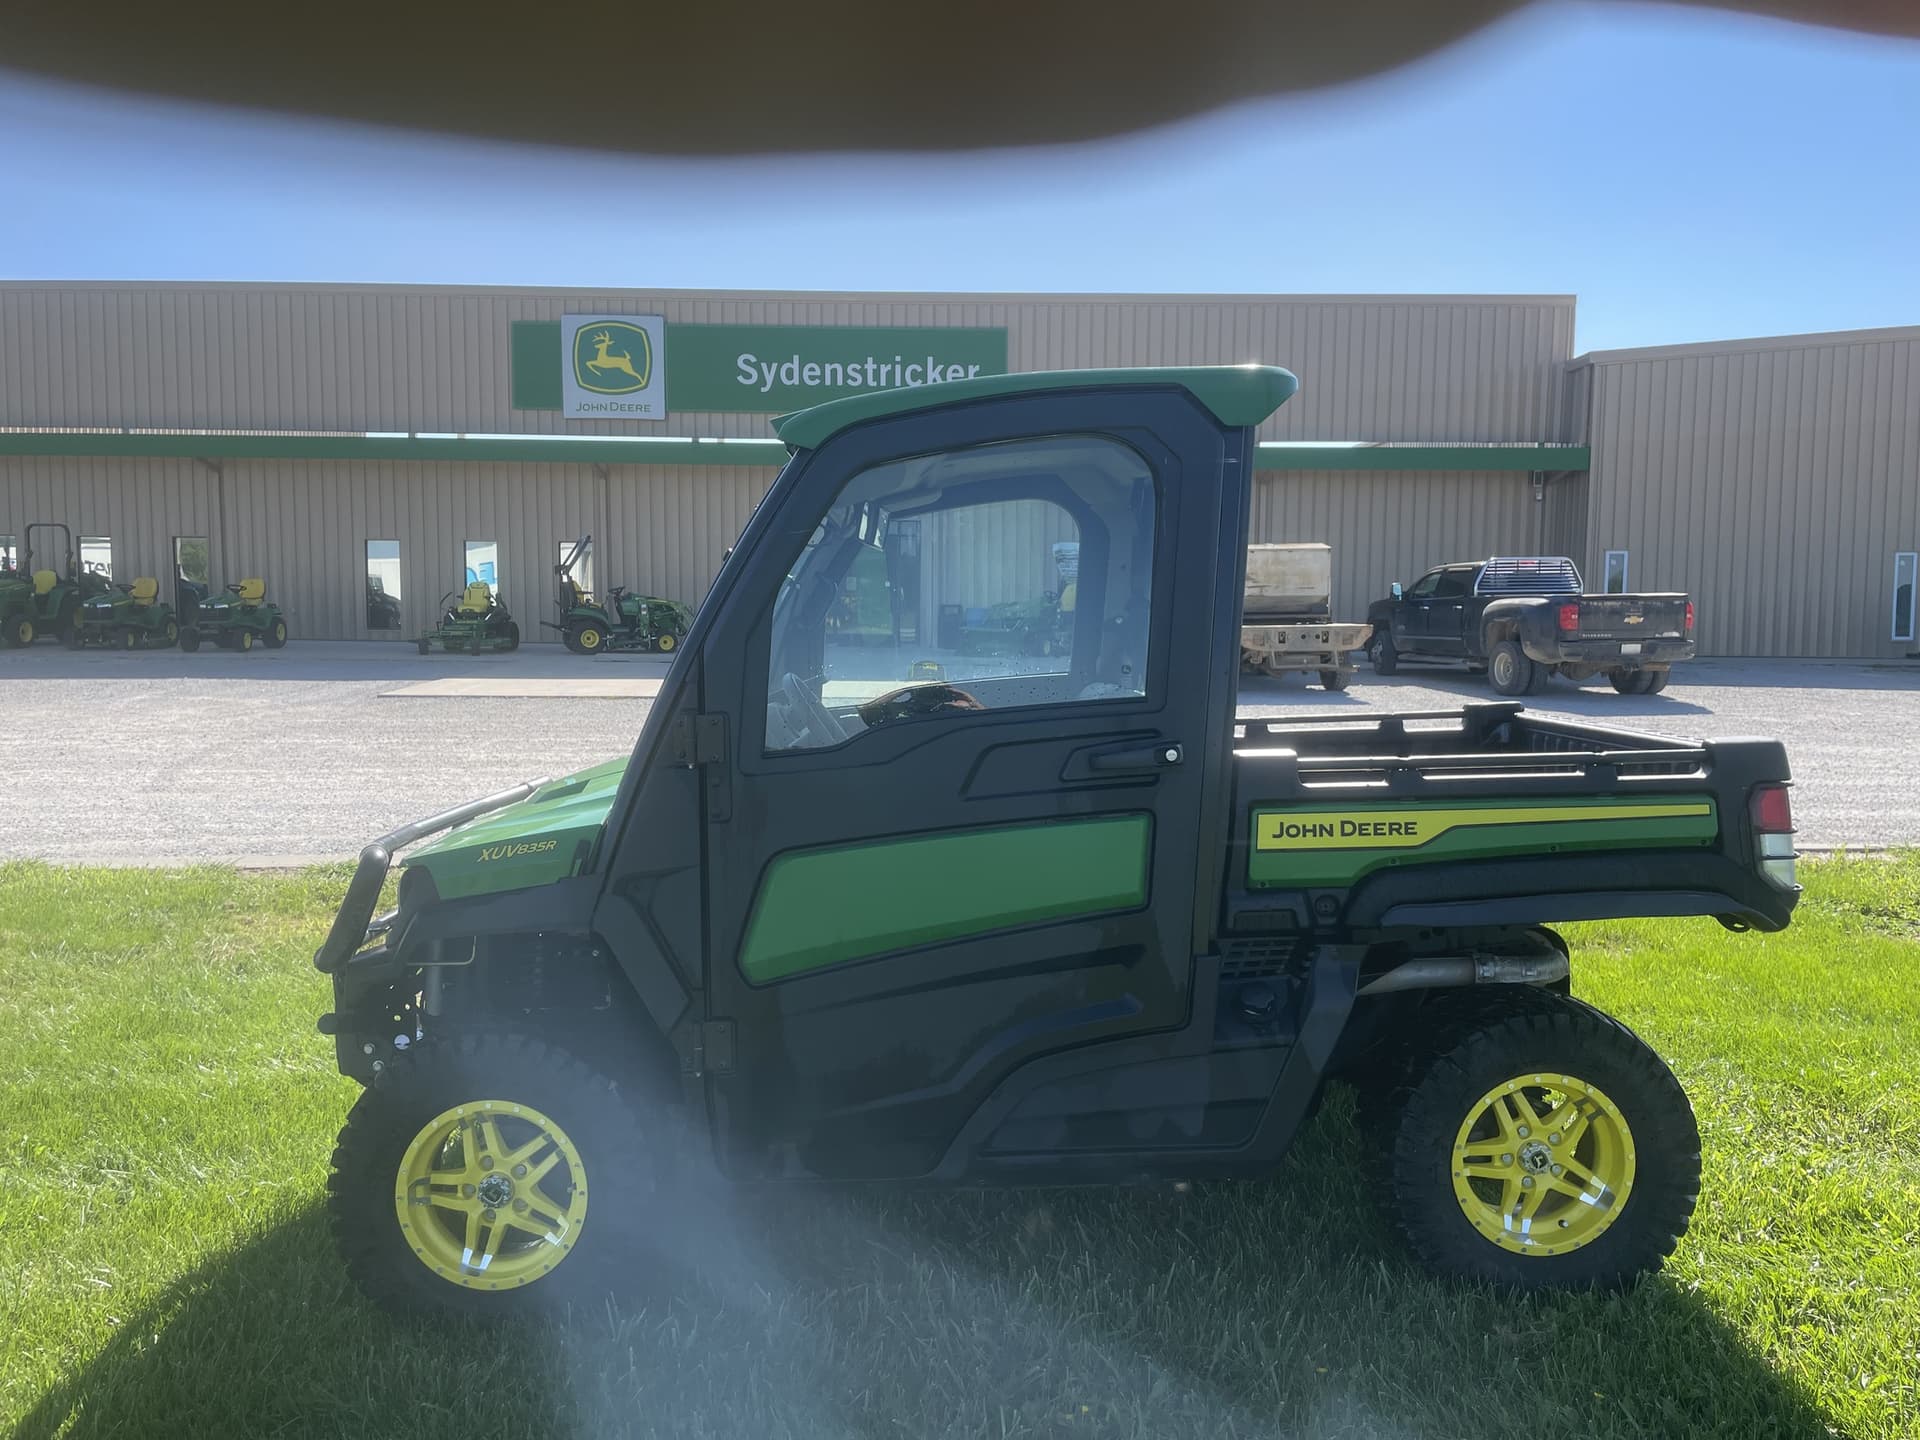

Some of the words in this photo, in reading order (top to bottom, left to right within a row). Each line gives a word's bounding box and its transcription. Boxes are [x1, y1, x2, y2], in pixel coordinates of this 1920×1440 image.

[736, 353, 980, 393] Sydenstricker
[575, 402, 608, 412] JOHN
[609, 402, 652, 413] DEERE
[1272, 821, 1334, 839] JOHN
[1339, 820, 1418, 837] DEERE
[476, 840, 557, 862] XUV835R
